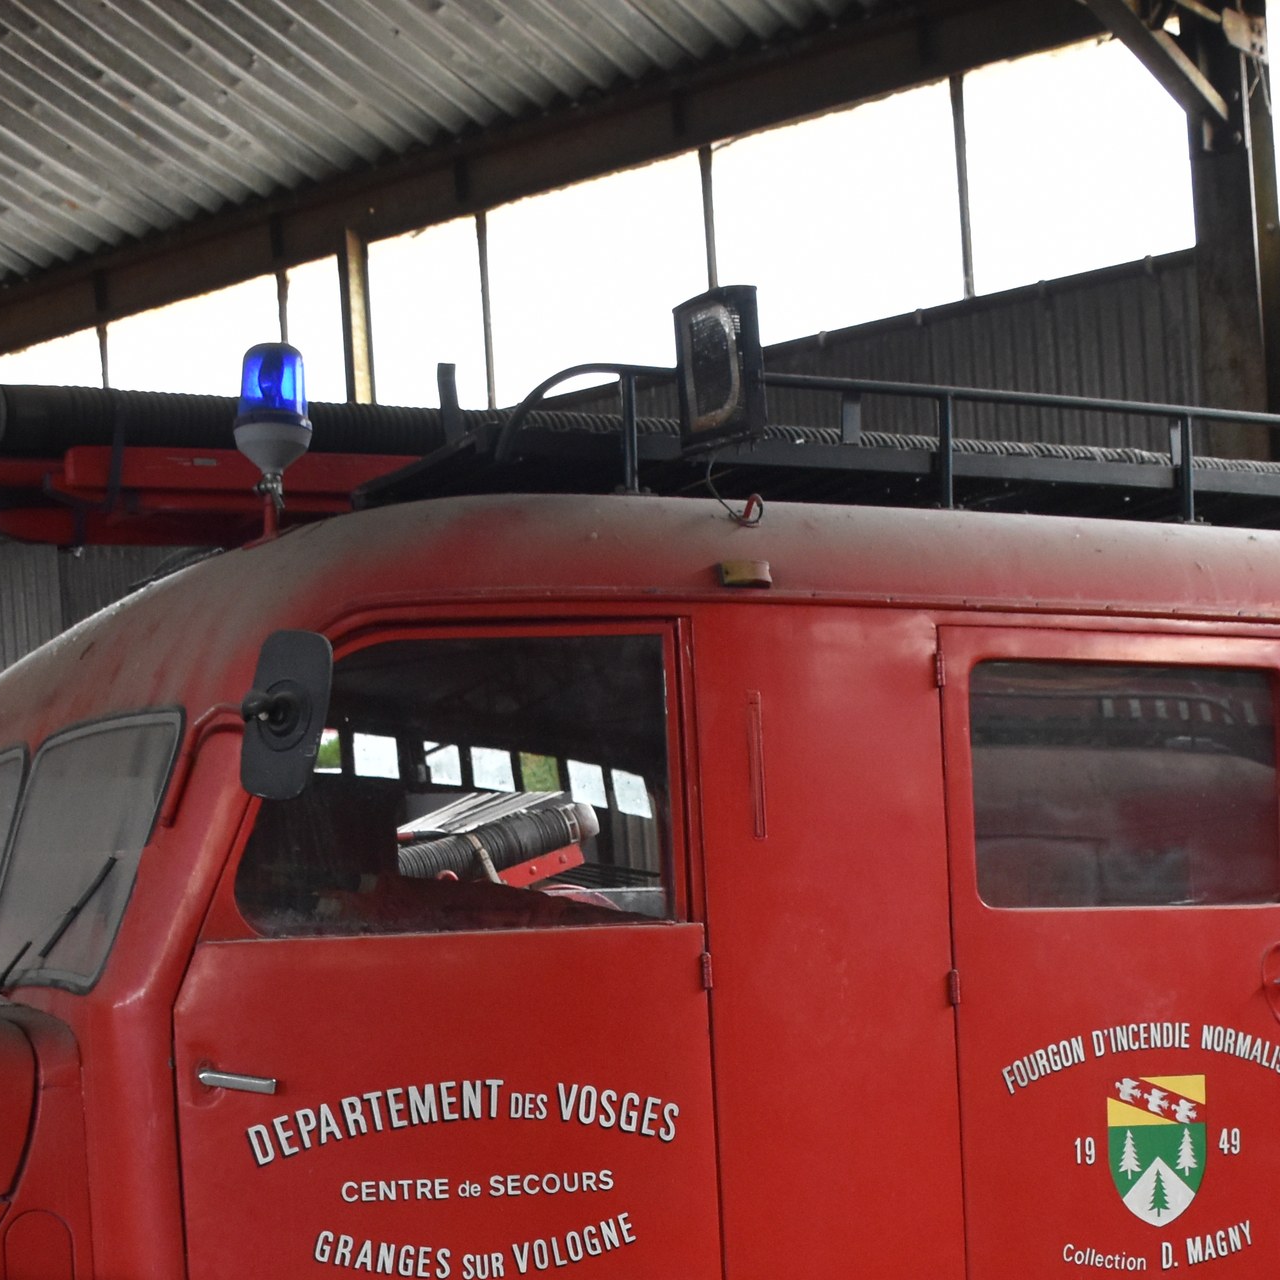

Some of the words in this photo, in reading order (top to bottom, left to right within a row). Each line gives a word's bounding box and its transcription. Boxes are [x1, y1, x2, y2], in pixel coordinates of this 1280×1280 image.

[1002, 1035, 1086, 1094] FOURGON
[1091, 1021, 1191, 1057] D'INCENDIE
[246, 1078, 504, 1166] DEPARTEMENT
[510, 1092, 548, 1120] DES
[557, 1082, 680, 1142] VOSGES
[1074, 1136, 1096, 1165] 19
[1218, 1127, 1241, 1155] 49
[341, 1178, 450, 1203] CENTRE
[457, 1180, 482, 1198] de
[489, 1169, 614, 1197] SECOURS
[314, 1230, 451, 1279] GRANGES
[462, 1252, 505, 1280] SUR
[511, 1212, 637, 1274] VOLOGNE
[1062, 1243, 1147, 1271] Collection
[1161, 1241, 1179, 1269] D.
[1186, 1220, 1252, 1265] MAGNY
